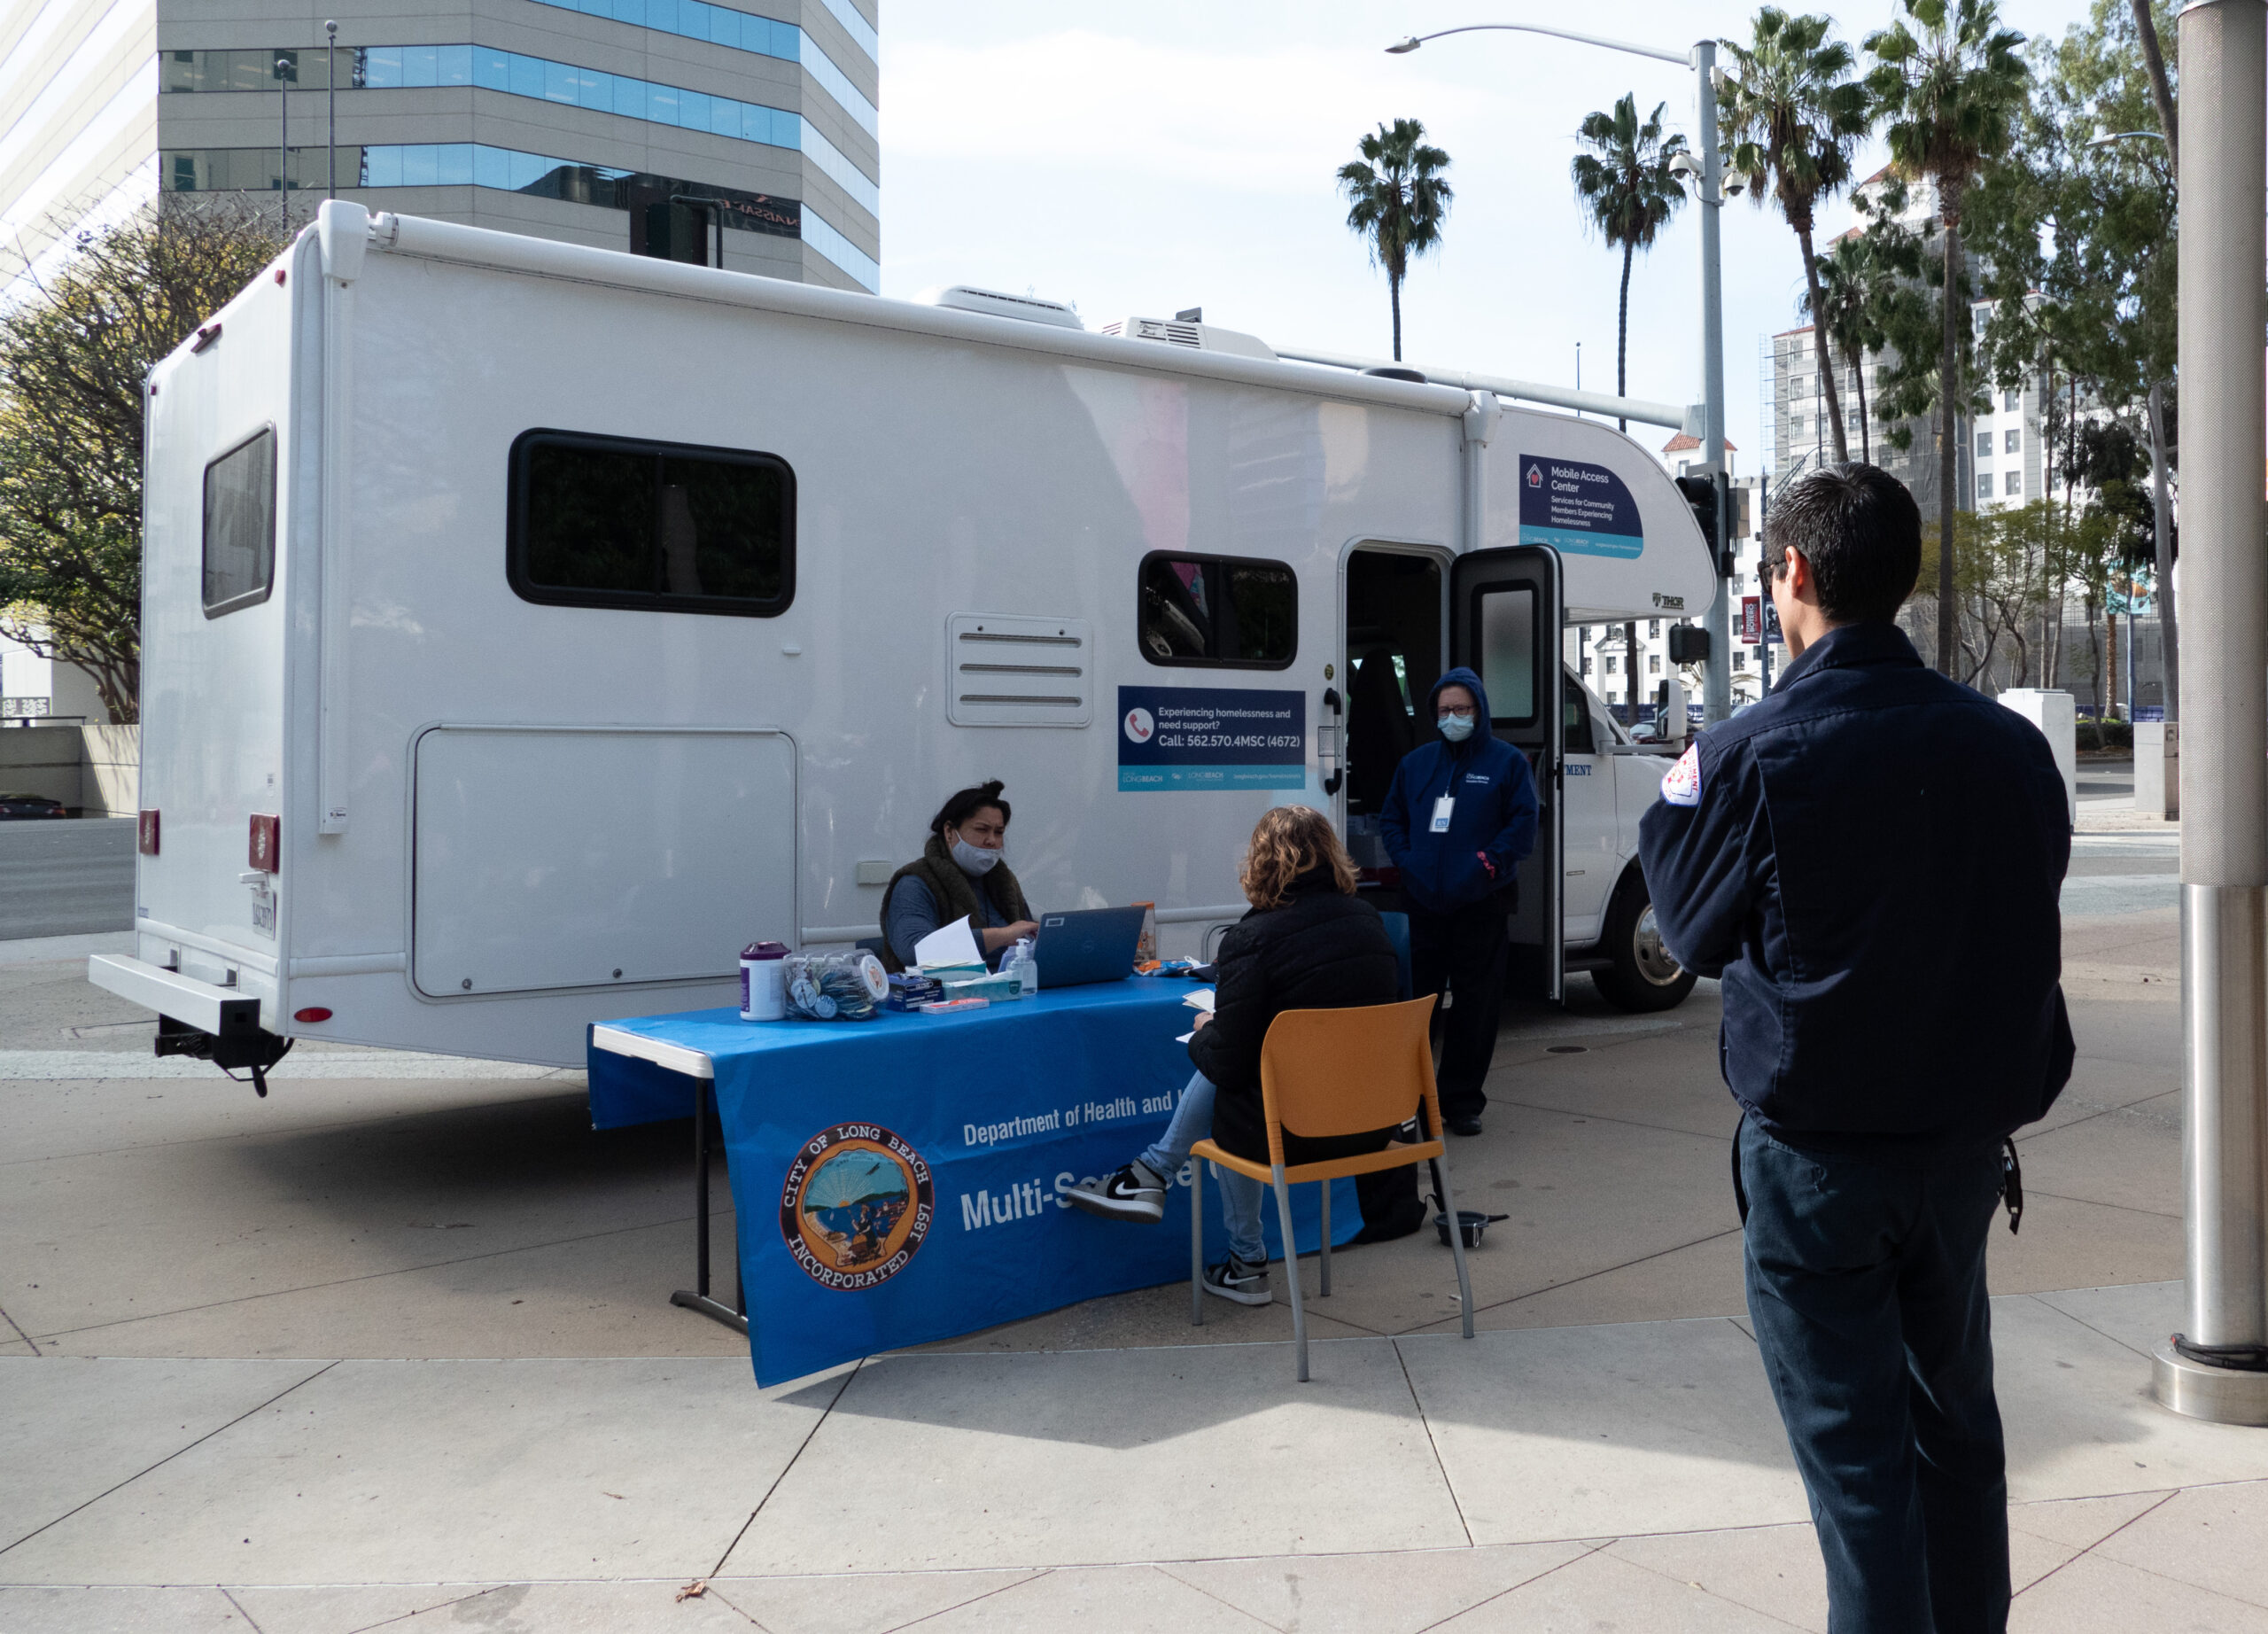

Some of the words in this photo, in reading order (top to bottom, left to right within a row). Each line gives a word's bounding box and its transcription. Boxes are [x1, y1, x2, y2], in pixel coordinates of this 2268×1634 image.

[1551, 466, 1580, 479] Mobile
[1581, 470, 1609, 484] Access
[1551, 479, 1580, 493] Center
[1551, 495, 1574, 505] Services
[1583, 499, 1614, 511] Community
[1551, 505, 1577, 516] Members
[1578, 509, 1612, 521] Experiencing
[1551, 516, 1591, 526] Homelessness
[1662, 595, 1683, 607] THOR
[1159, 707, 1215, 719] Experiencing
[1216, 708, 1274, 718] homelessness
[1275, 710, 1291, 719] and
[1159, 720, 1181, 729] need
[1183, 720, 1220, 731] support?
[1159, 735, 1184, 747] Call:
[1187, 735, 1265, 747] 562.570.4MSC
[1267, 735, 1301, 748] (4672)
[964, 1112, 1060, 1147] Department
[1065, 1105, 1080, 1127] of
[1084, 1096, 1137, 1123] Health
[1143, 1091, 1172, 1114] and
[784, 1159, 808, 1207] CITY
[809, 1134, 828, 1155] OF
[837, 1125, 881, 1140] LONG
[888, 1136, 929, 1185] BEACH
[788, 1233, 908, 1288] INCORPORATED
[909, 1202, 932, 1242] 1897
